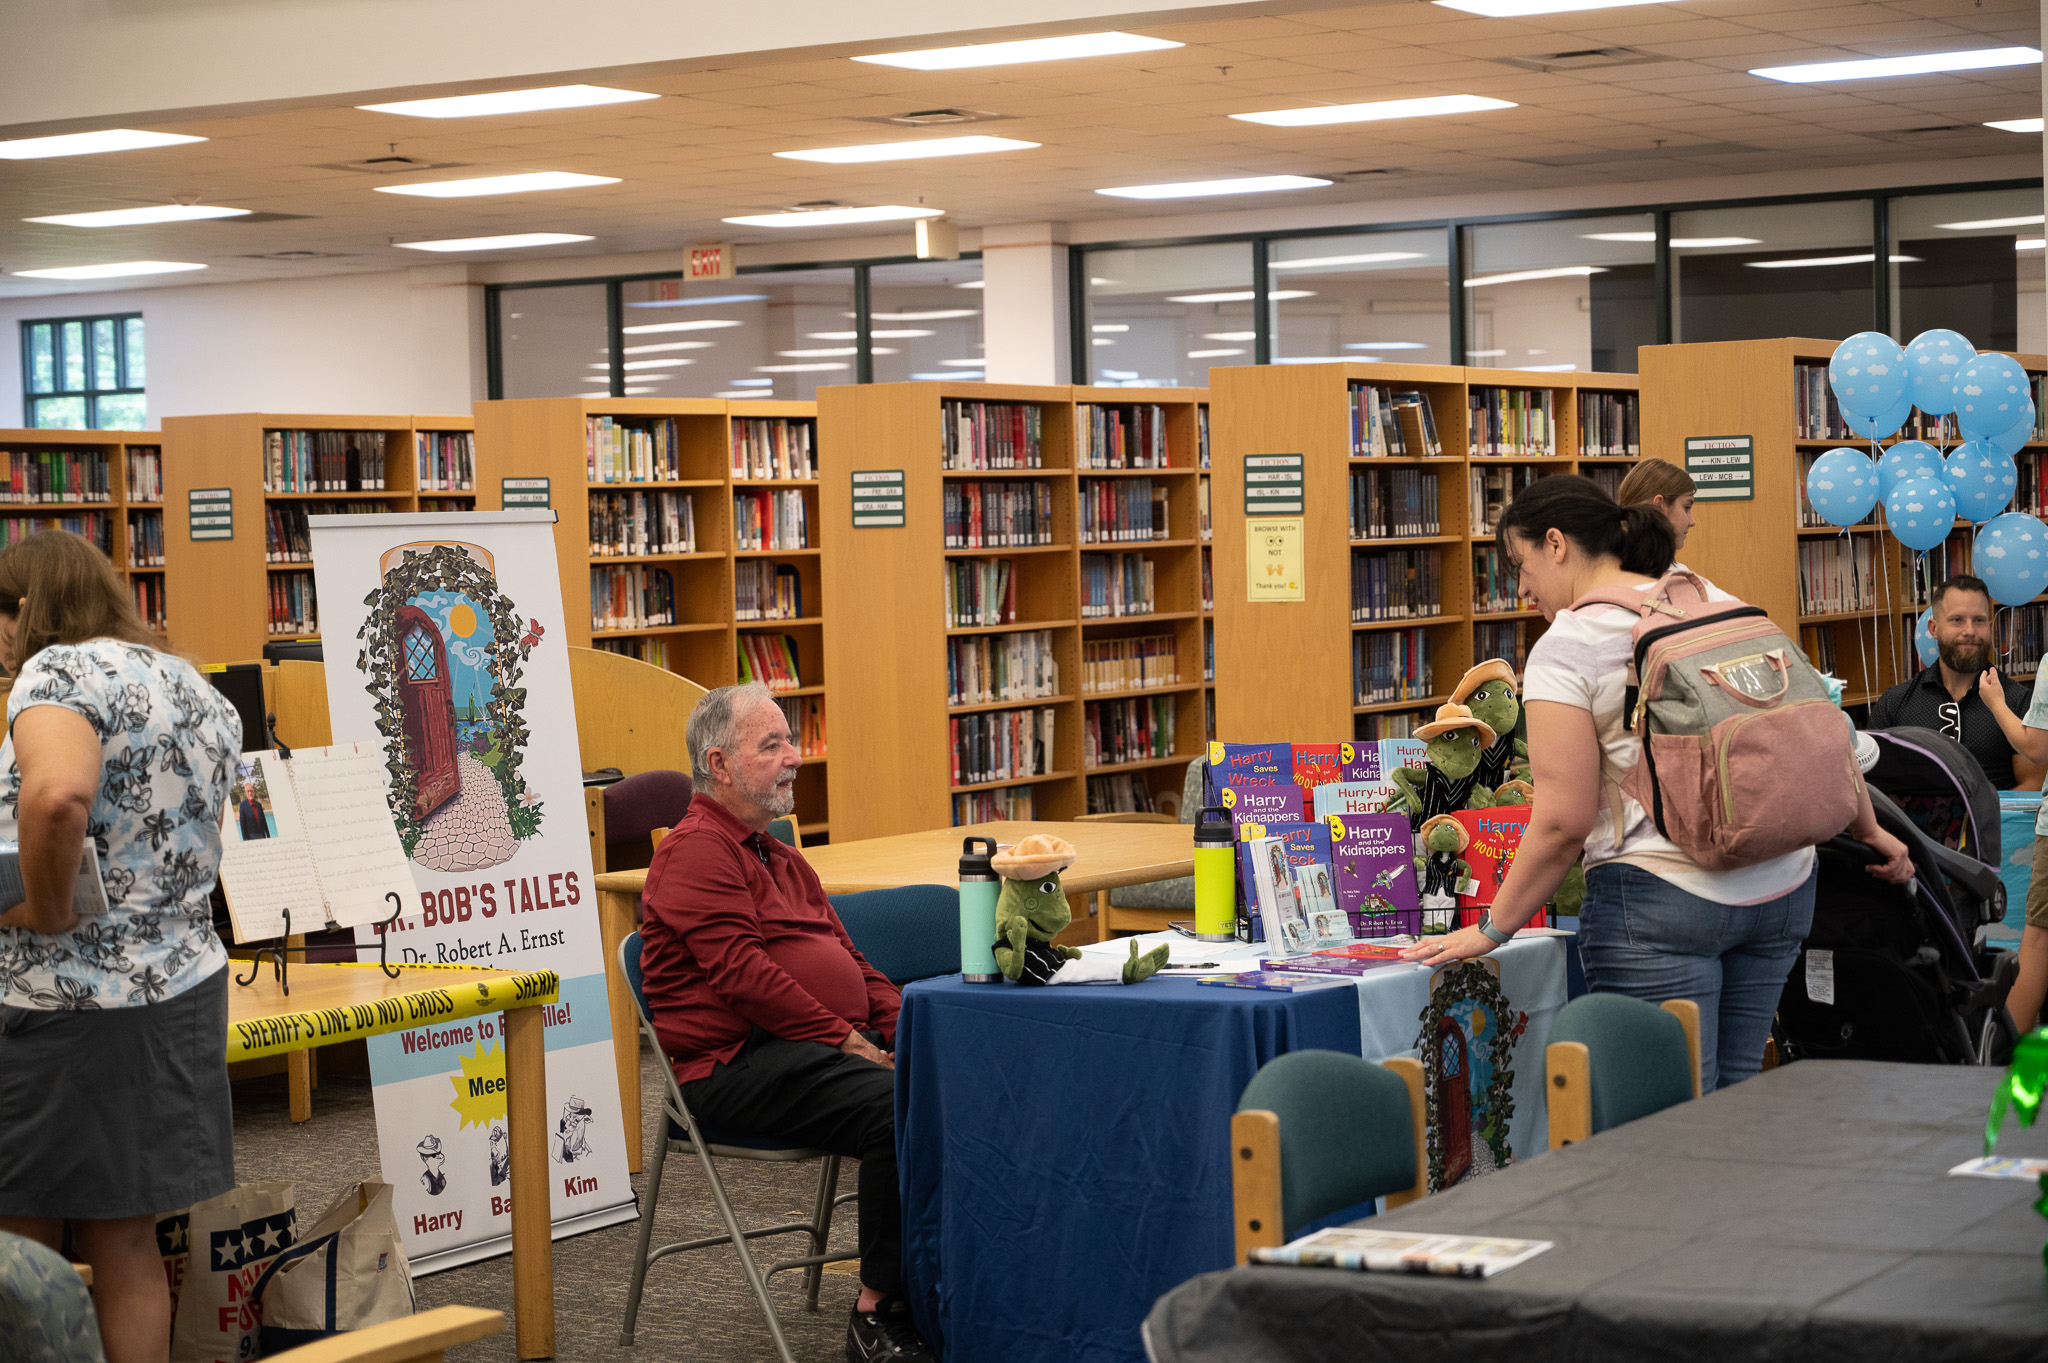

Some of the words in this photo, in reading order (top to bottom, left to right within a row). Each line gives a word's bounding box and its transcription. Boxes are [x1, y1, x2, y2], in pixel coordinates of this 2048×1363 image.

[692, 248, 721, 276] EXIT
[1726, 456, 1741, 464] LEW
[1699, 473, 1714, 481] LEW
[1718, 472, 1733, 480] MCB
[1230, 749, 1273, 768] Harry
[1296, 750, 1341, 768] Harry
[1253, 765, 1279, 773] Saves
[1228, 773, 1277, 787] Wreck
[1338, 786, 1396, 799] Hurry-Up
[1244, 794, 1287, 809] Harry
[1346, 800, 1389, 813] Harry
[1234, 812, 1300, 824] Kidnappers
[1348, 826, 1393, 842] Harry
[1478, 818, 1528, 837] Harry
[1290, 843, 1315, 852] Saves
[1339, 844, 1406, 858] Kidnappers
[420, 882, 498, 928] BOB'S
[503, 870, 581, 915] TALES
[402, 947, 432, 964] Dr.
[435, 938, 493, 964] Robert
[497, 932, 517, 955] A.
[520, 928, 566, 951] Ernst
[236, 1011, 315, 1050] SHERIFF'S
[317, 1006, 351, 1037] LINE
[349, 1002, 374, 1030] DO
[376, 997, 404, 1026] NOT
[403, 989, 455, 1020] CROSS
[400, 1025, 474, 1055] Welcome
[478, 1018, 494, 1040] to
[468, 1076, 506, 1098] Mee
[564, 1175, 599, 1198] Kim
[413, 1209, 464, 1236] Harry
